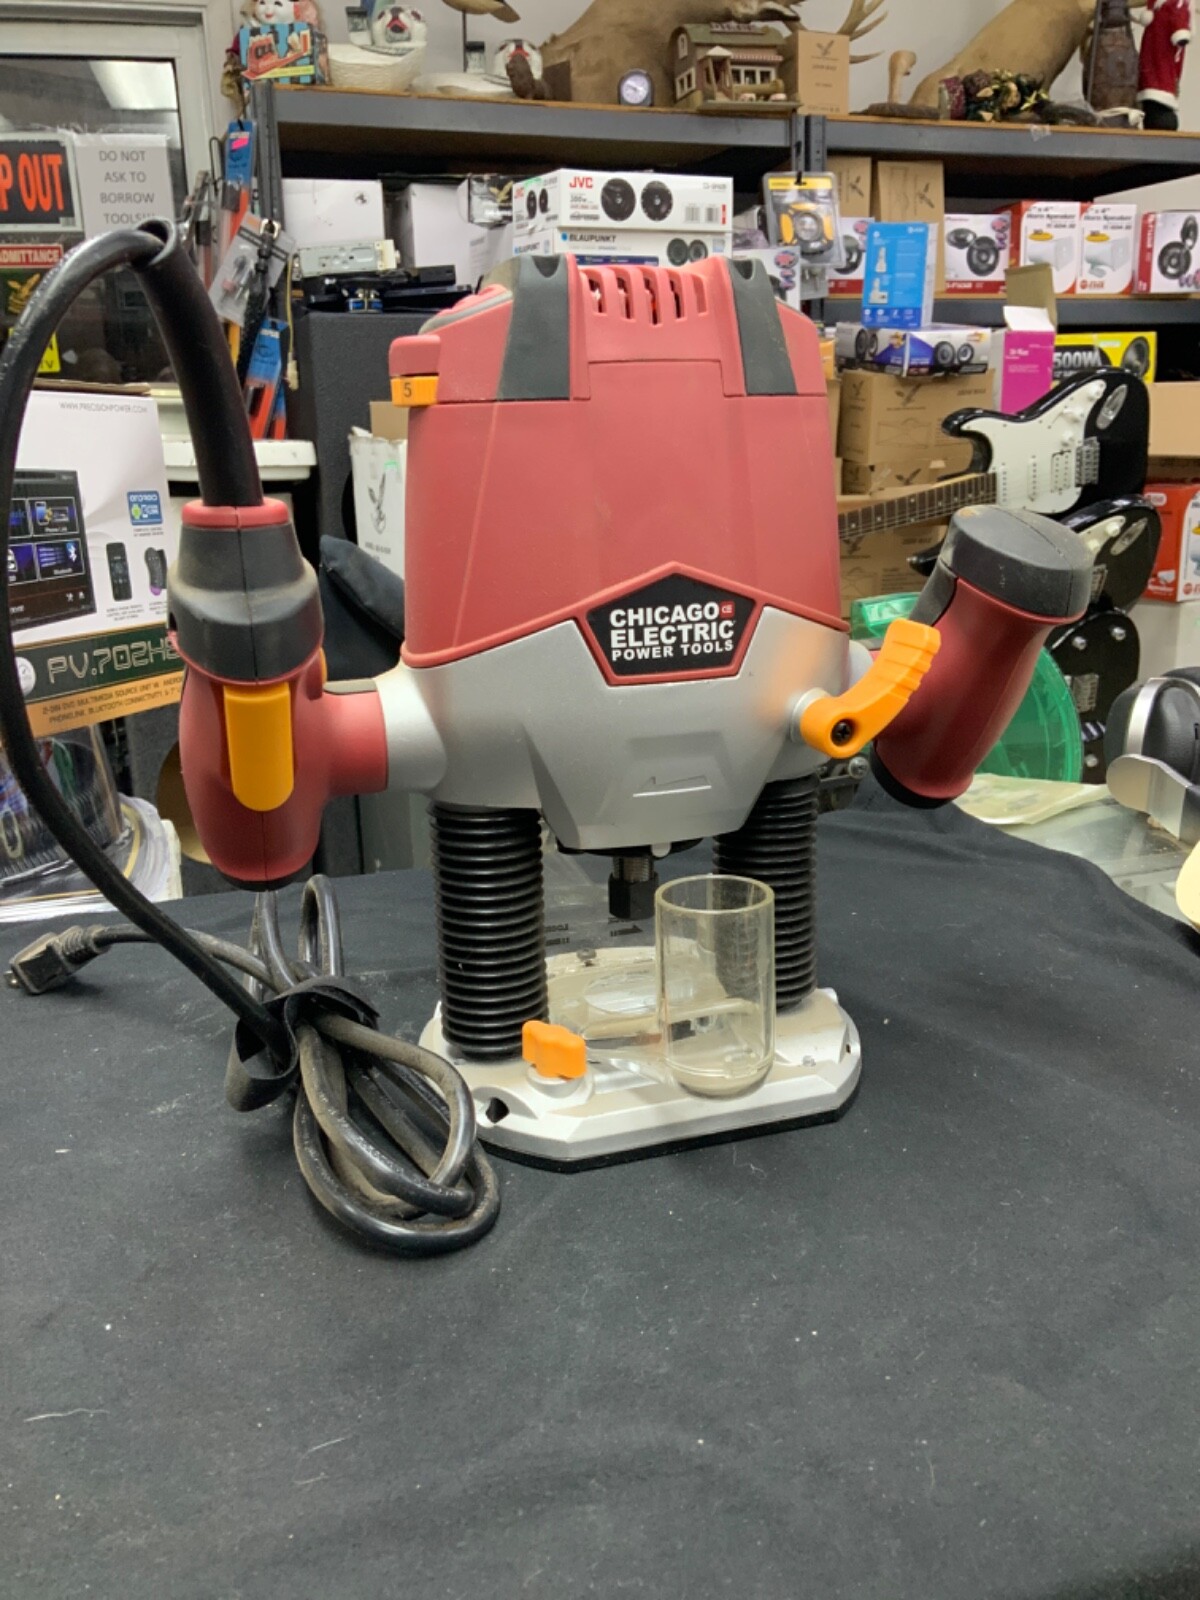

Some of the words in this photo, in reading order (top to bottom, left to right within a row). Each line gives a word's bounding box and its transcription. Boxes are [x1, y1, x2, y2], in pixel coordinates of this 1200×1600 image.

[99, 150, 117, 161] DO
[120, 150, 146, 161] NOT
[18, 153, 64, 212] OUT
[103, 171, 128, 183] ASK
[130, 171, 147, 183] TO
[569, 177, 593, 189] JVC
[99, 192, 155, 204] BORROW
[569, 233, 616, 243] BLAUPUNKT
[0, 249, 59, 263] DMITTANCE
[403, 382, 412, 398] 5
[610, 602, 719, 627] CHICAGO
[610, 620, 734, 648] ELECTRIC
[611, 645, 673, 662] POWER
[680, 640, 733, 656] TOOLS
[114, 686, 138, 698] SOURCE
